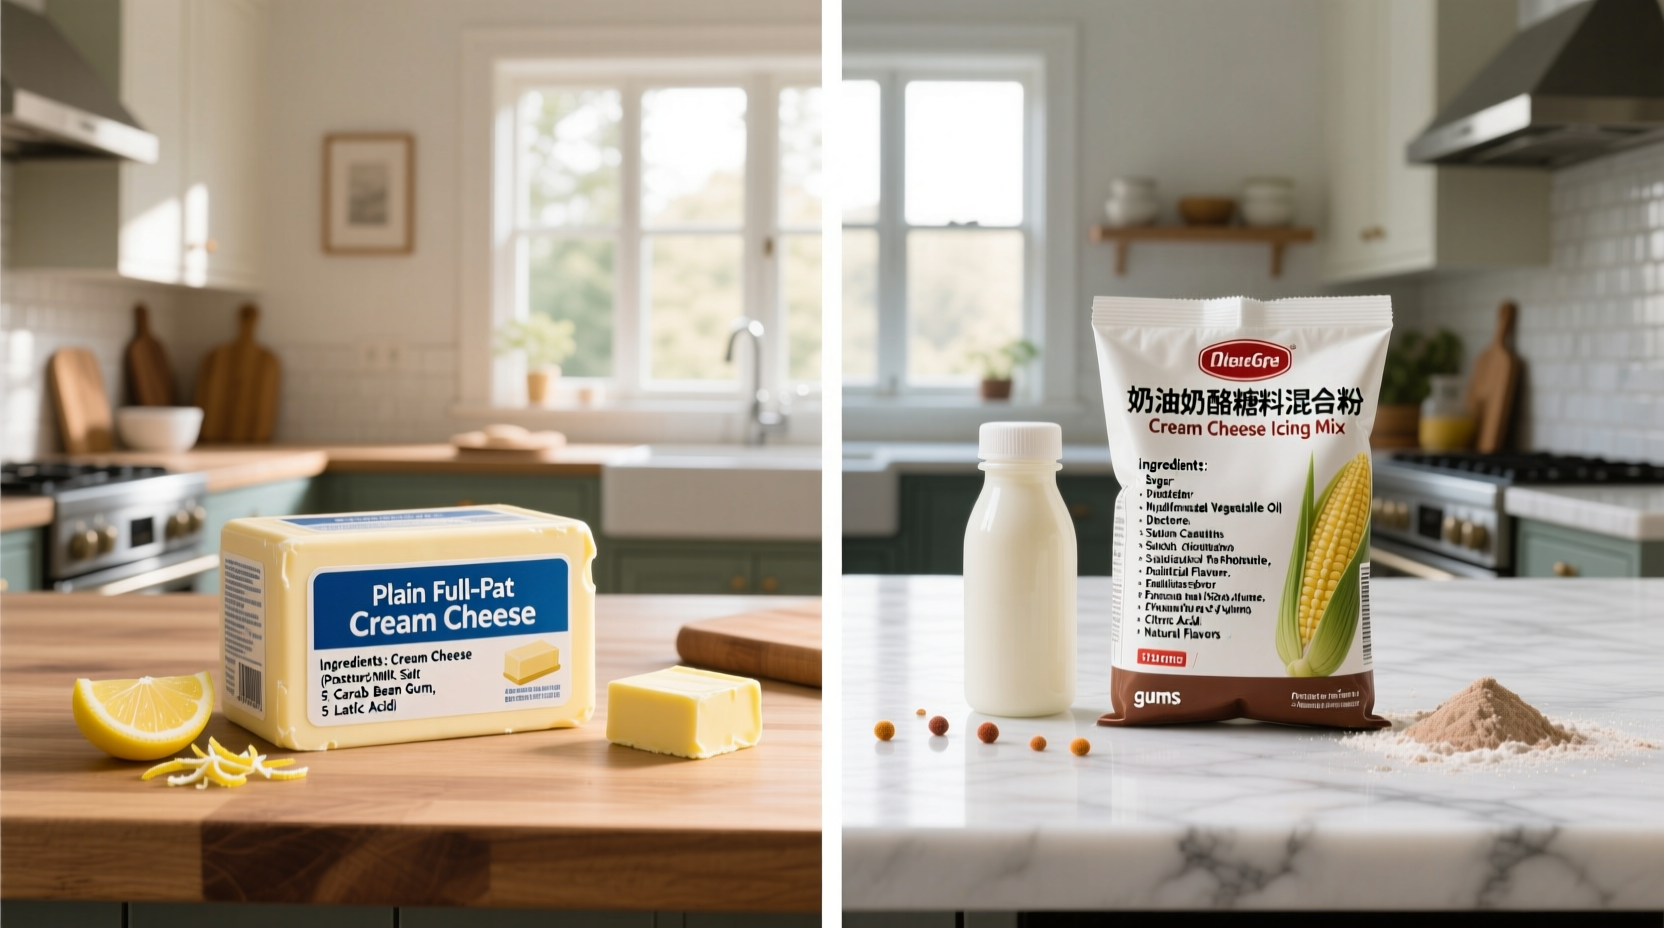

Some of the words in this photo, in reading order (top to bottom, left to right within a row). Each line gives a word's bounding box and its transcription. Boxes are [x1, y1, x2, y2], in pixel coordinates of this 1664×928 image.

[1127, 385, 1364, 417] 奶油奶酪糖料混合粉
[1149, 418, 1202, 435] Cream
[1207, 420, 1266, 436] Cheese
[1271, 419, 1310, 439] Icing
[1315, 419, 1346, 435] Mix
[373, 582, 426, 606] Plain
[433, 577, 515, 602] Full-Pat
[349, 610, 437, 637] Cream
[443, 604, 536, 630] Cheese
[1144, 626, 1180, 639] Natural
[1183, 627, 1221, 640] Flavors
[320, 655, 388, 672] Ingredients:
[391, 653, 427, 665] Cream
[431, 649, 472, 662] Cheese
[333, 686, 369, 701] Carab
[373, 686, 402, 697] Bean
[405, 683, 436, 695] Gum,
[1133, 690, 1182, 709] gums
